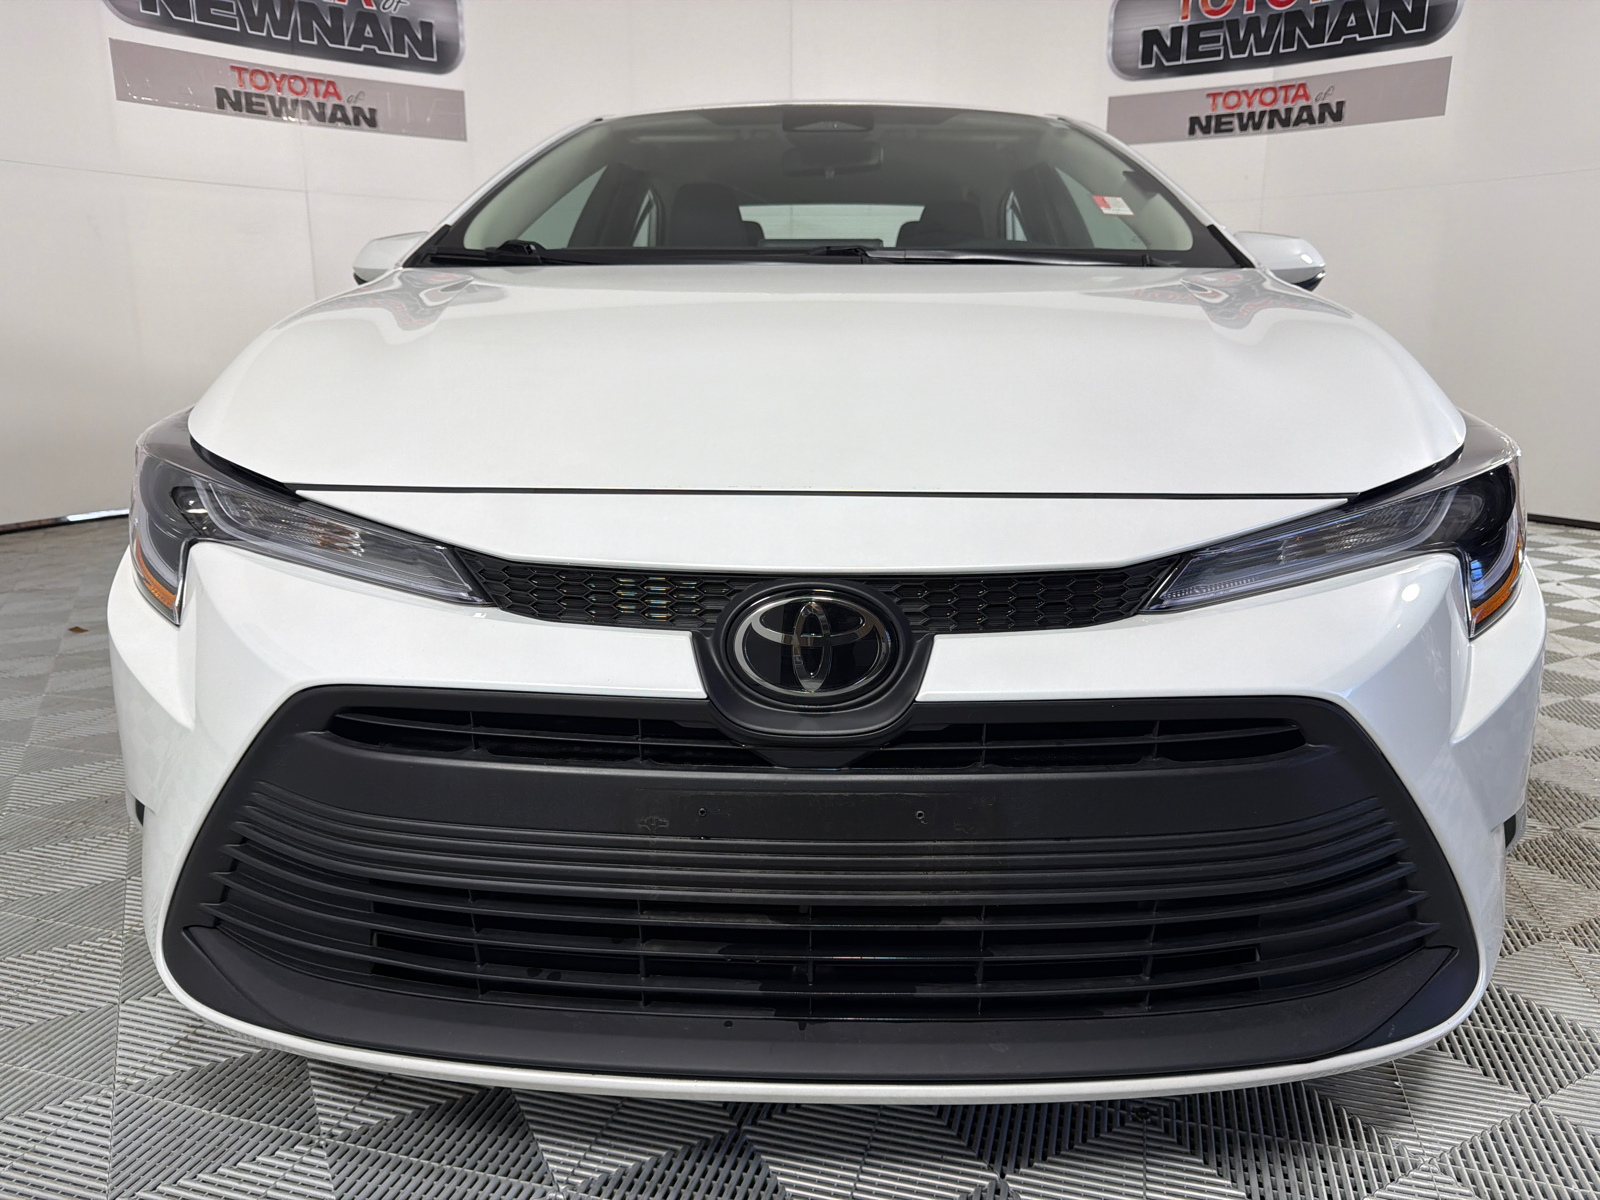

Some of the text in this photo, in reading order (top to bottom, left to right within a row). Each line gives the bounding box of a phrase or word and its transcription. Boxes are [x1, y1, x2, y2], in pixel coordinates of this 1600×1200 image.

[1138, 0, 1429, 69] NEWNAN
[230, 65, 366, 104] TOYOTA of
[1206, 82, 1336, 112] TOYOTA of
[214, 86, 378, 128] NEWNAN
[1188, 100, 1346, 136] NEWNAN
